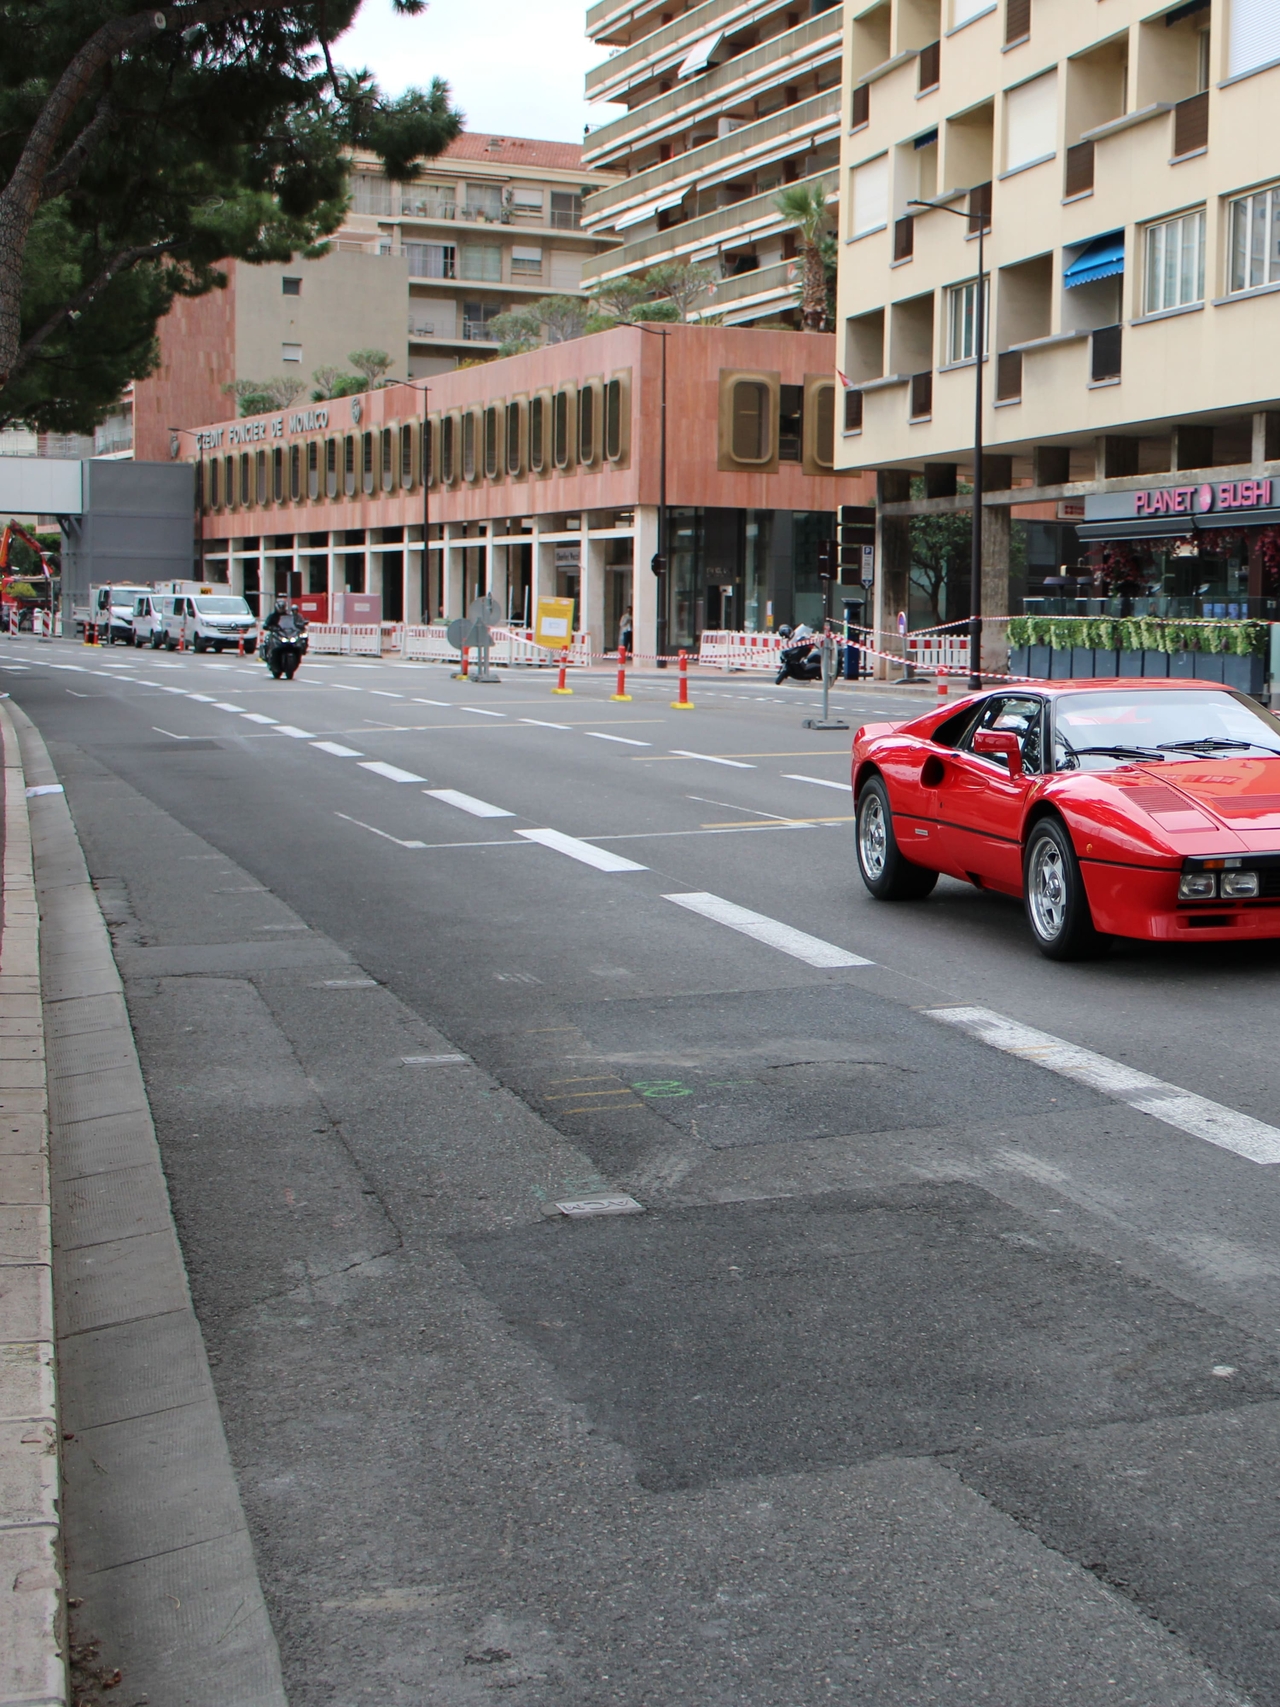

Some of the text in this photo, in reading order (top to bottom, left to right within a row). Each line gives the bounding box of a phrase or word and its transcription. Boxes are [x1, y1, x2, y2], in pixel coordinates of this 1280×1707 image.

[229, 421, 266, 444] FONCIER
[271, 417, 284, 438] DE
[289, 408, 328, 434] MONACO
[1134, 479, 1272, 514] PLANET SUSHI
